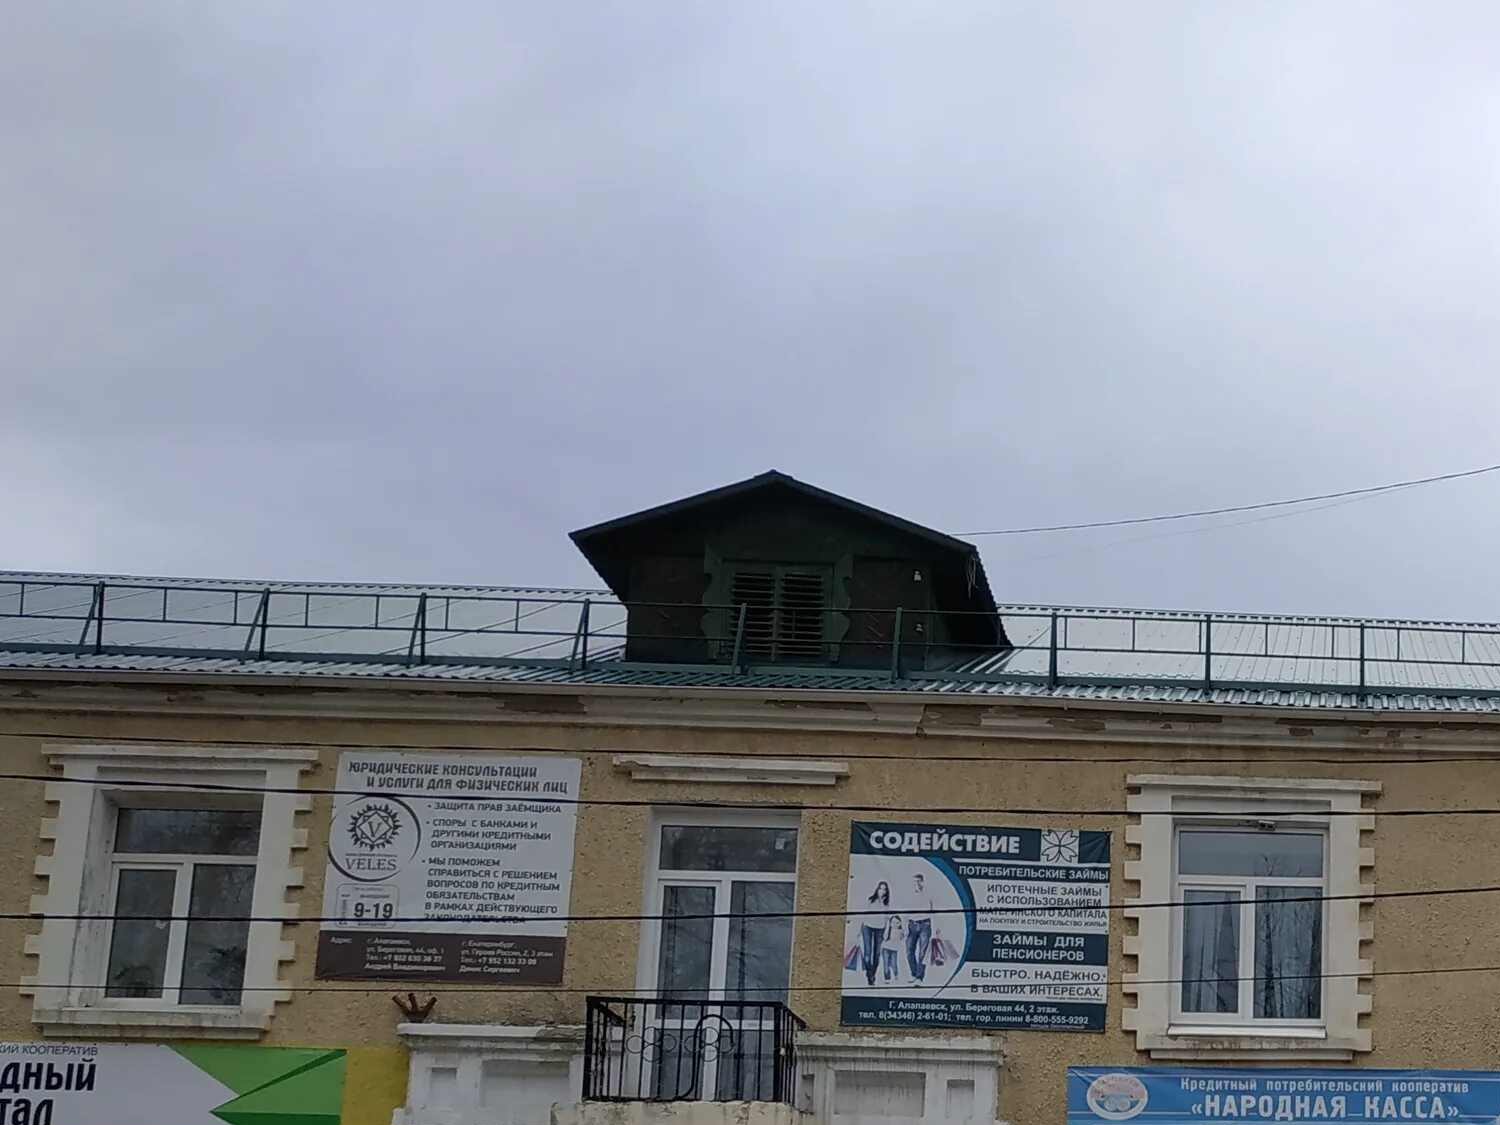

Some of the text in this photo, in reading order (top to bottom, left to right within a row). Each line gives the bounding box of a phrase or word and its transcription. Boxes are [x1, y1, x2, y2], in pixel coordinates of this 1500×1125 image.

[349, 762, 538, 778] ЮРИДИЧЕСКИЕ КОНСУЛЬТАЦИИ
[366, 776, 568, 795] И УСЛУГИ ДЛЯ ФИЗИЧЕСКИХ ЛИЦ
[434, 802, 561, 813] ЗАЩИТА ПРАВ ЗАЁМЩИКА
[432, 818, 538, 829] СПОРЫ С БАНКАМИ И
[431, 829, 552, 841] ДРУГИМИ КРЕДИТНЫМИ
[869, 829, 1021, 854] СОДЕЙСТВИЕ
[430, 840, 517, 851] ОРГАНИЗАЦИЯМИ
[345, 858, 397, 871] VELES
[428, 857, 501, 867] МЫ ПОМОЖЕМ
[427, 868, 558, 880] СПРАВИТЬСЯ С РЕШЕНИЕМ
[958, 865, 1109, 880] ПОТРЕБИТЕЛЬСКИЕ ЗАЙМЫ
[426, 880, 560, 891] ВОПРОСОВ ПО КРЕДИТНЫМ
[987, 884, 1102, 897] ИПОТЕЧНЫЕ ЗАЙМЫ
[425, 891, 516, 901] ОБЯЗАТЕЛЬСТВАМ
[986, 895, 1101, 907] С ИСПОЛЬЗОВАНИЕМ
[353, 902, 394, 919] 9-19
[424, 902, 558, 914] В РАМКАХ ДЕЙСТВУЮЩЕГО
[979, 905, 1107, 919] МАТЕРИНСКОГО КАПИТАЛА
[1026, 919, 1083, 927] СТРОИТЕЛЬСТВО
[993, 932, 1085, 949] ЗАЙМЫ ДЛЯ
[992, 948, 1085, 961] ПЕНСИОНЕРОВ
[971, 968, 1105, 983] БЫСТРО. НАДЁЖНО.
[970, 985, 1104, 997] В ВАШИХ ИНТЕРЕСАХ.
[888, 1000, 1060, 1014] Г. Алапаевск, ул. Береговая 44, 2 этаж.
[858, 1011, 876, 1019] тел.
[955, 1014, 974, 1022] тел.
[975, 1016, 994, 1024] гор.
[1025, 1014, 1089, 1025] 8-800-555-9292
[23, 1045, 98, 1056] КООПЕРАТИВ
[1181, 1077, 1469, 1095] Кредитный потребительский кооператив
[1191, 1095, 1459, 1121] «НАРОДНАЯ КАССА»
